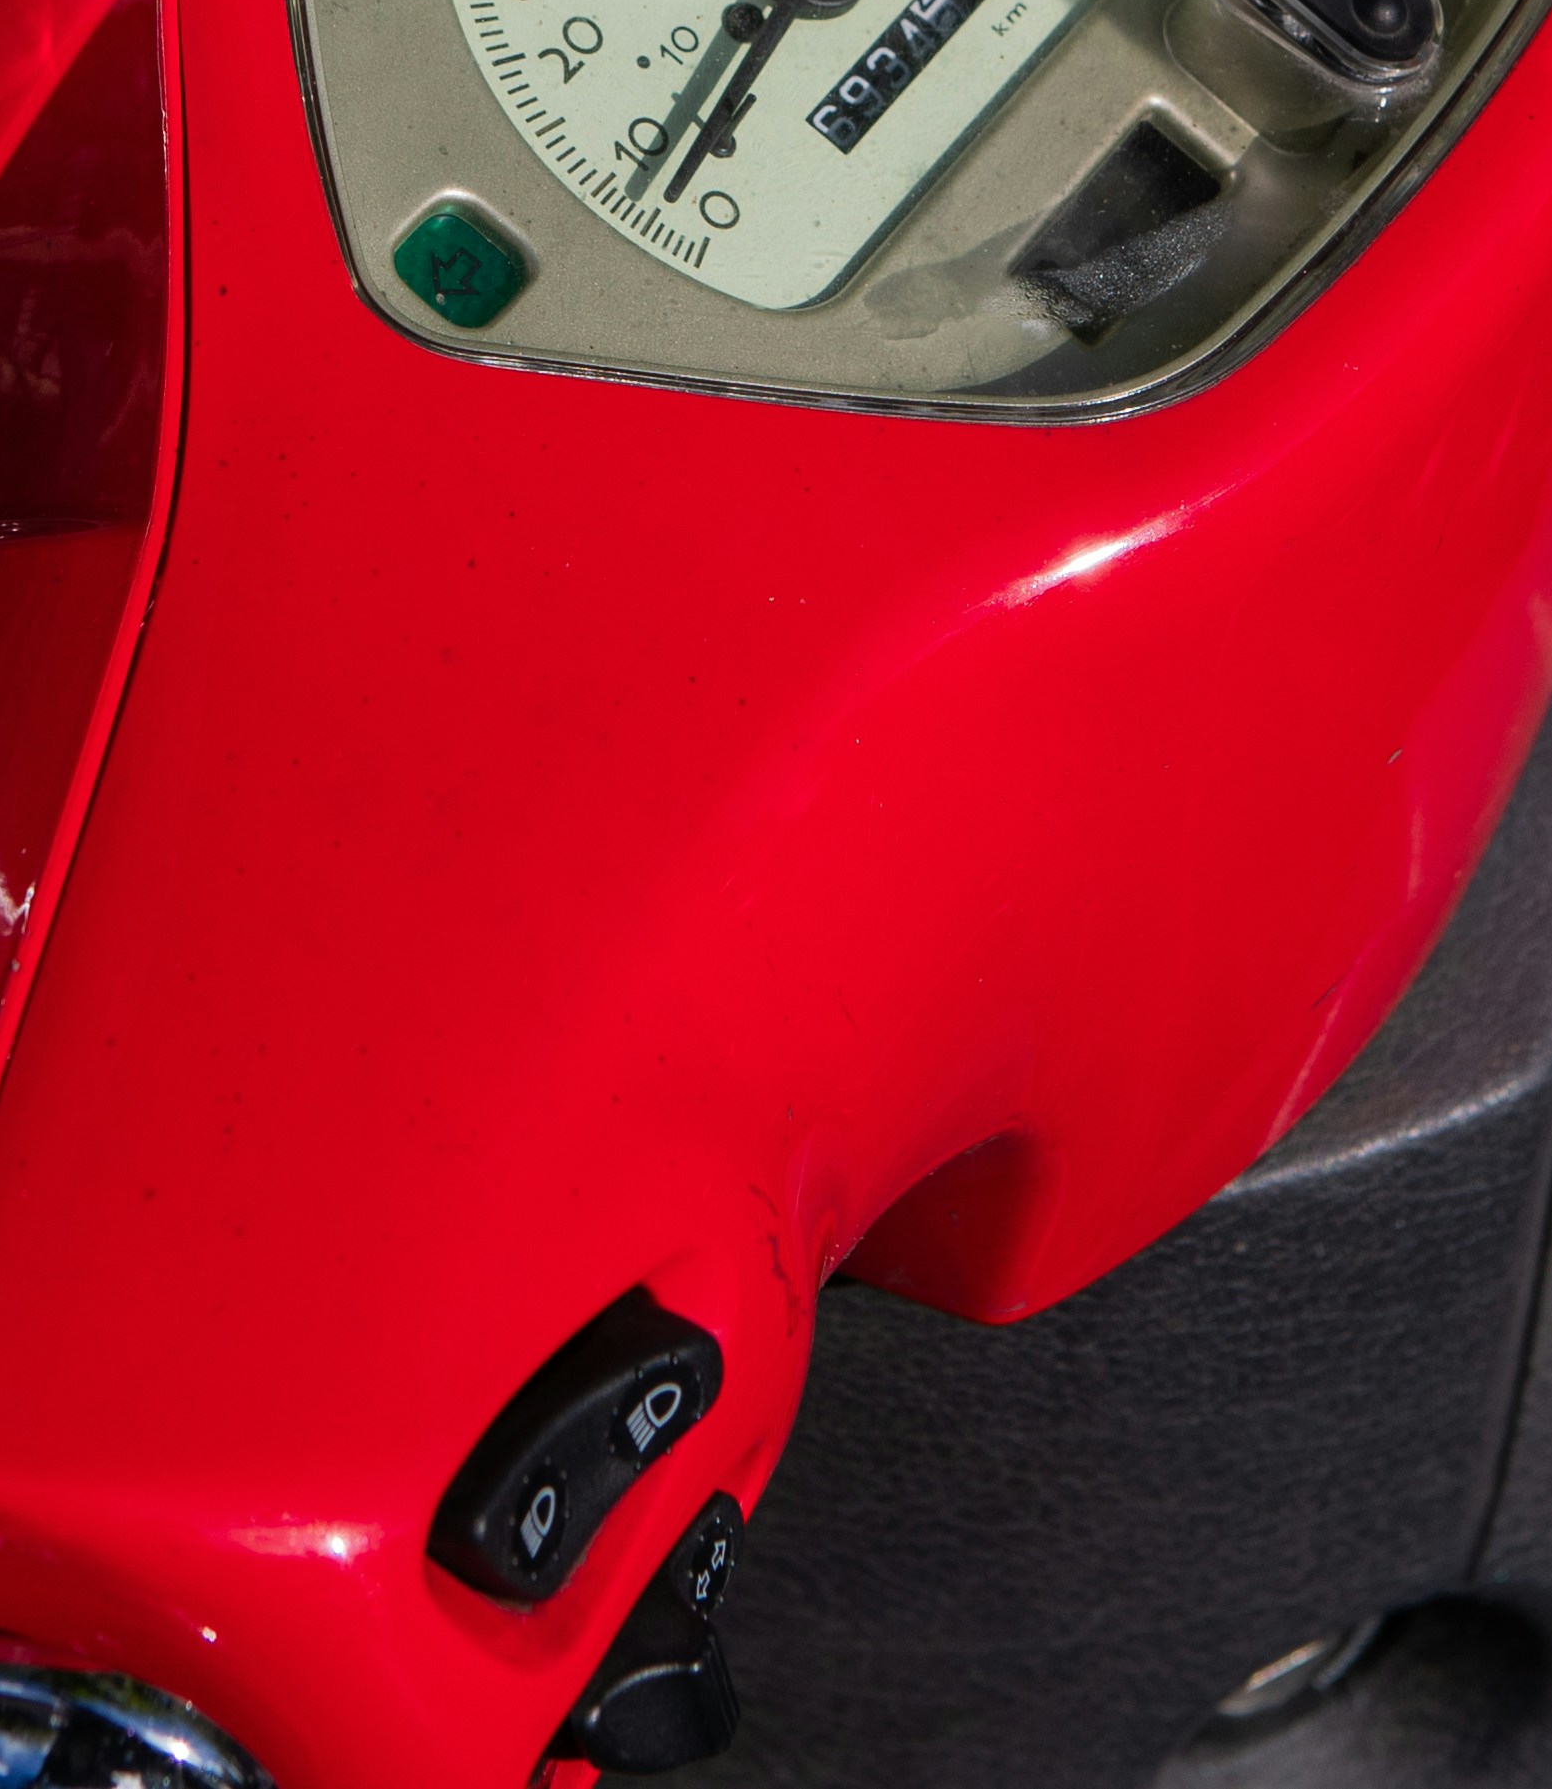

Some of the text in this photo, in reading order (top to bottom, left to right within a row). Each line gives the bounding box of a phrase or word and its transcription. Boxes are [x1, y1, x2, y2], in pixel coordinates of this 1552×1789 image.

[991, 2, 1027, 37] km
[537, 16, 603, 84] 20
[660, 26, 699, 65] 10
[613, 117, 669, 171] 10
[699, 190, 741, 230] 0
